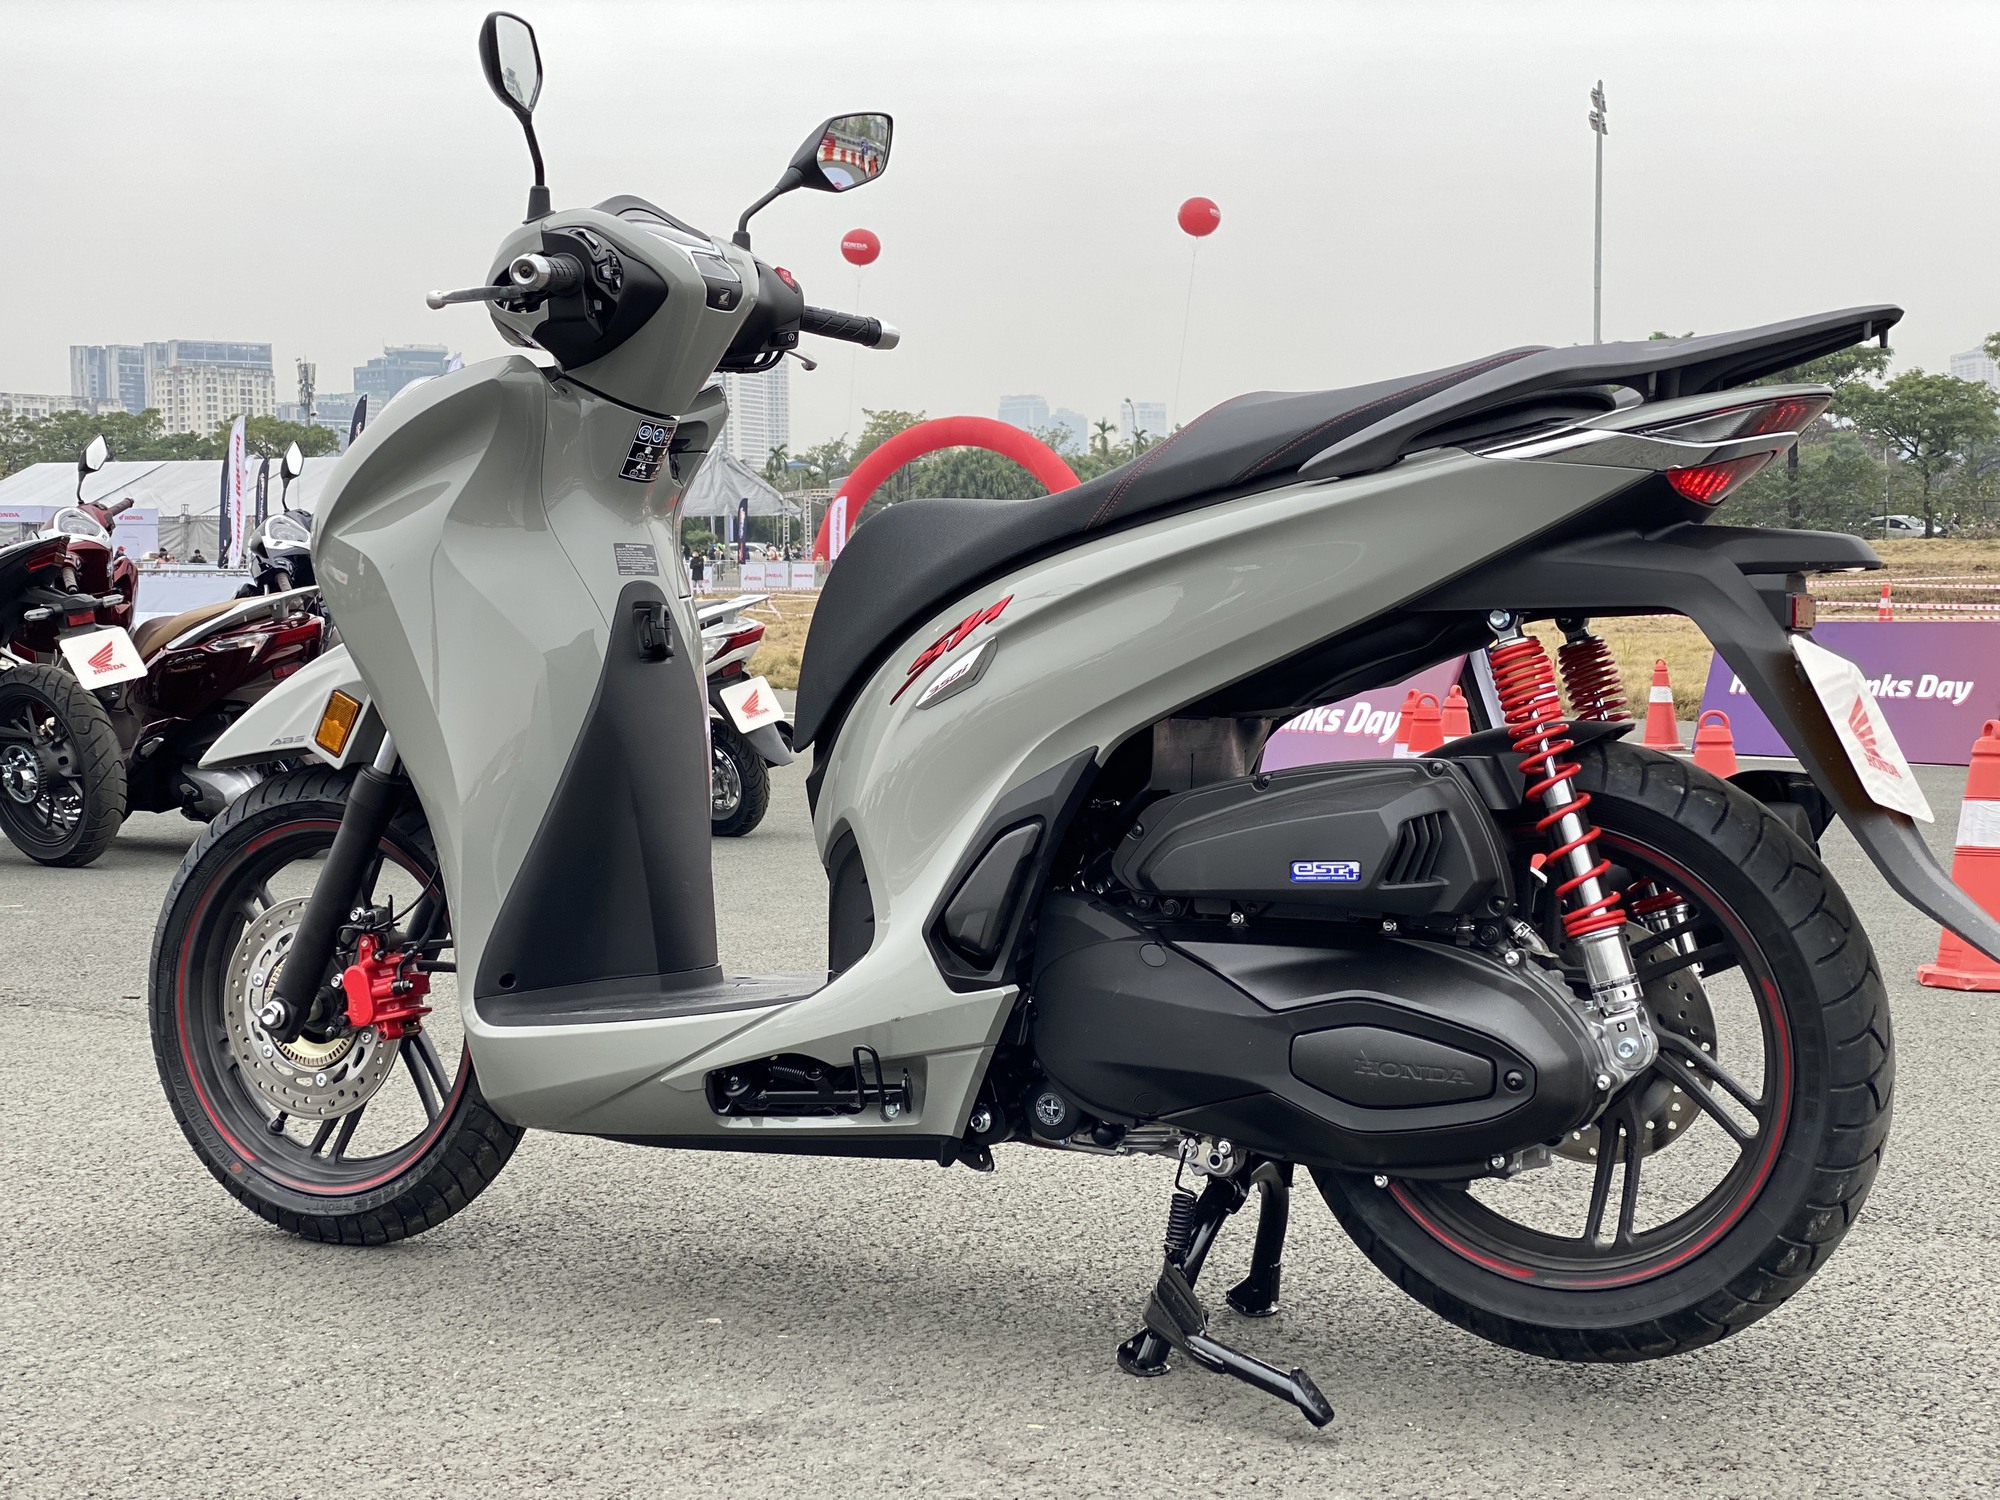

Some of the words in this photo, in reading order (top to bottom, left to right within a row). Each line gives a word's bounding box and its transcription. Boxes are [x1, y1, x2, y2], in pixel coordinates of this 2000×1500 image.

[93, 663, 127, 675] HONDA
[929, 663, 969, 695] 350i
[1865, 673, 1914, 698] nks
[1915, 673, 1974, 705] Day
[745, 707, 770, 720] HONDA
[1343, 702, 1403, 745] Day
[269, 734, 306, 746] ABS
[1864, 752, 1903, 779] HONDA
[1354, 1058, 1474, 1087] HONDA
